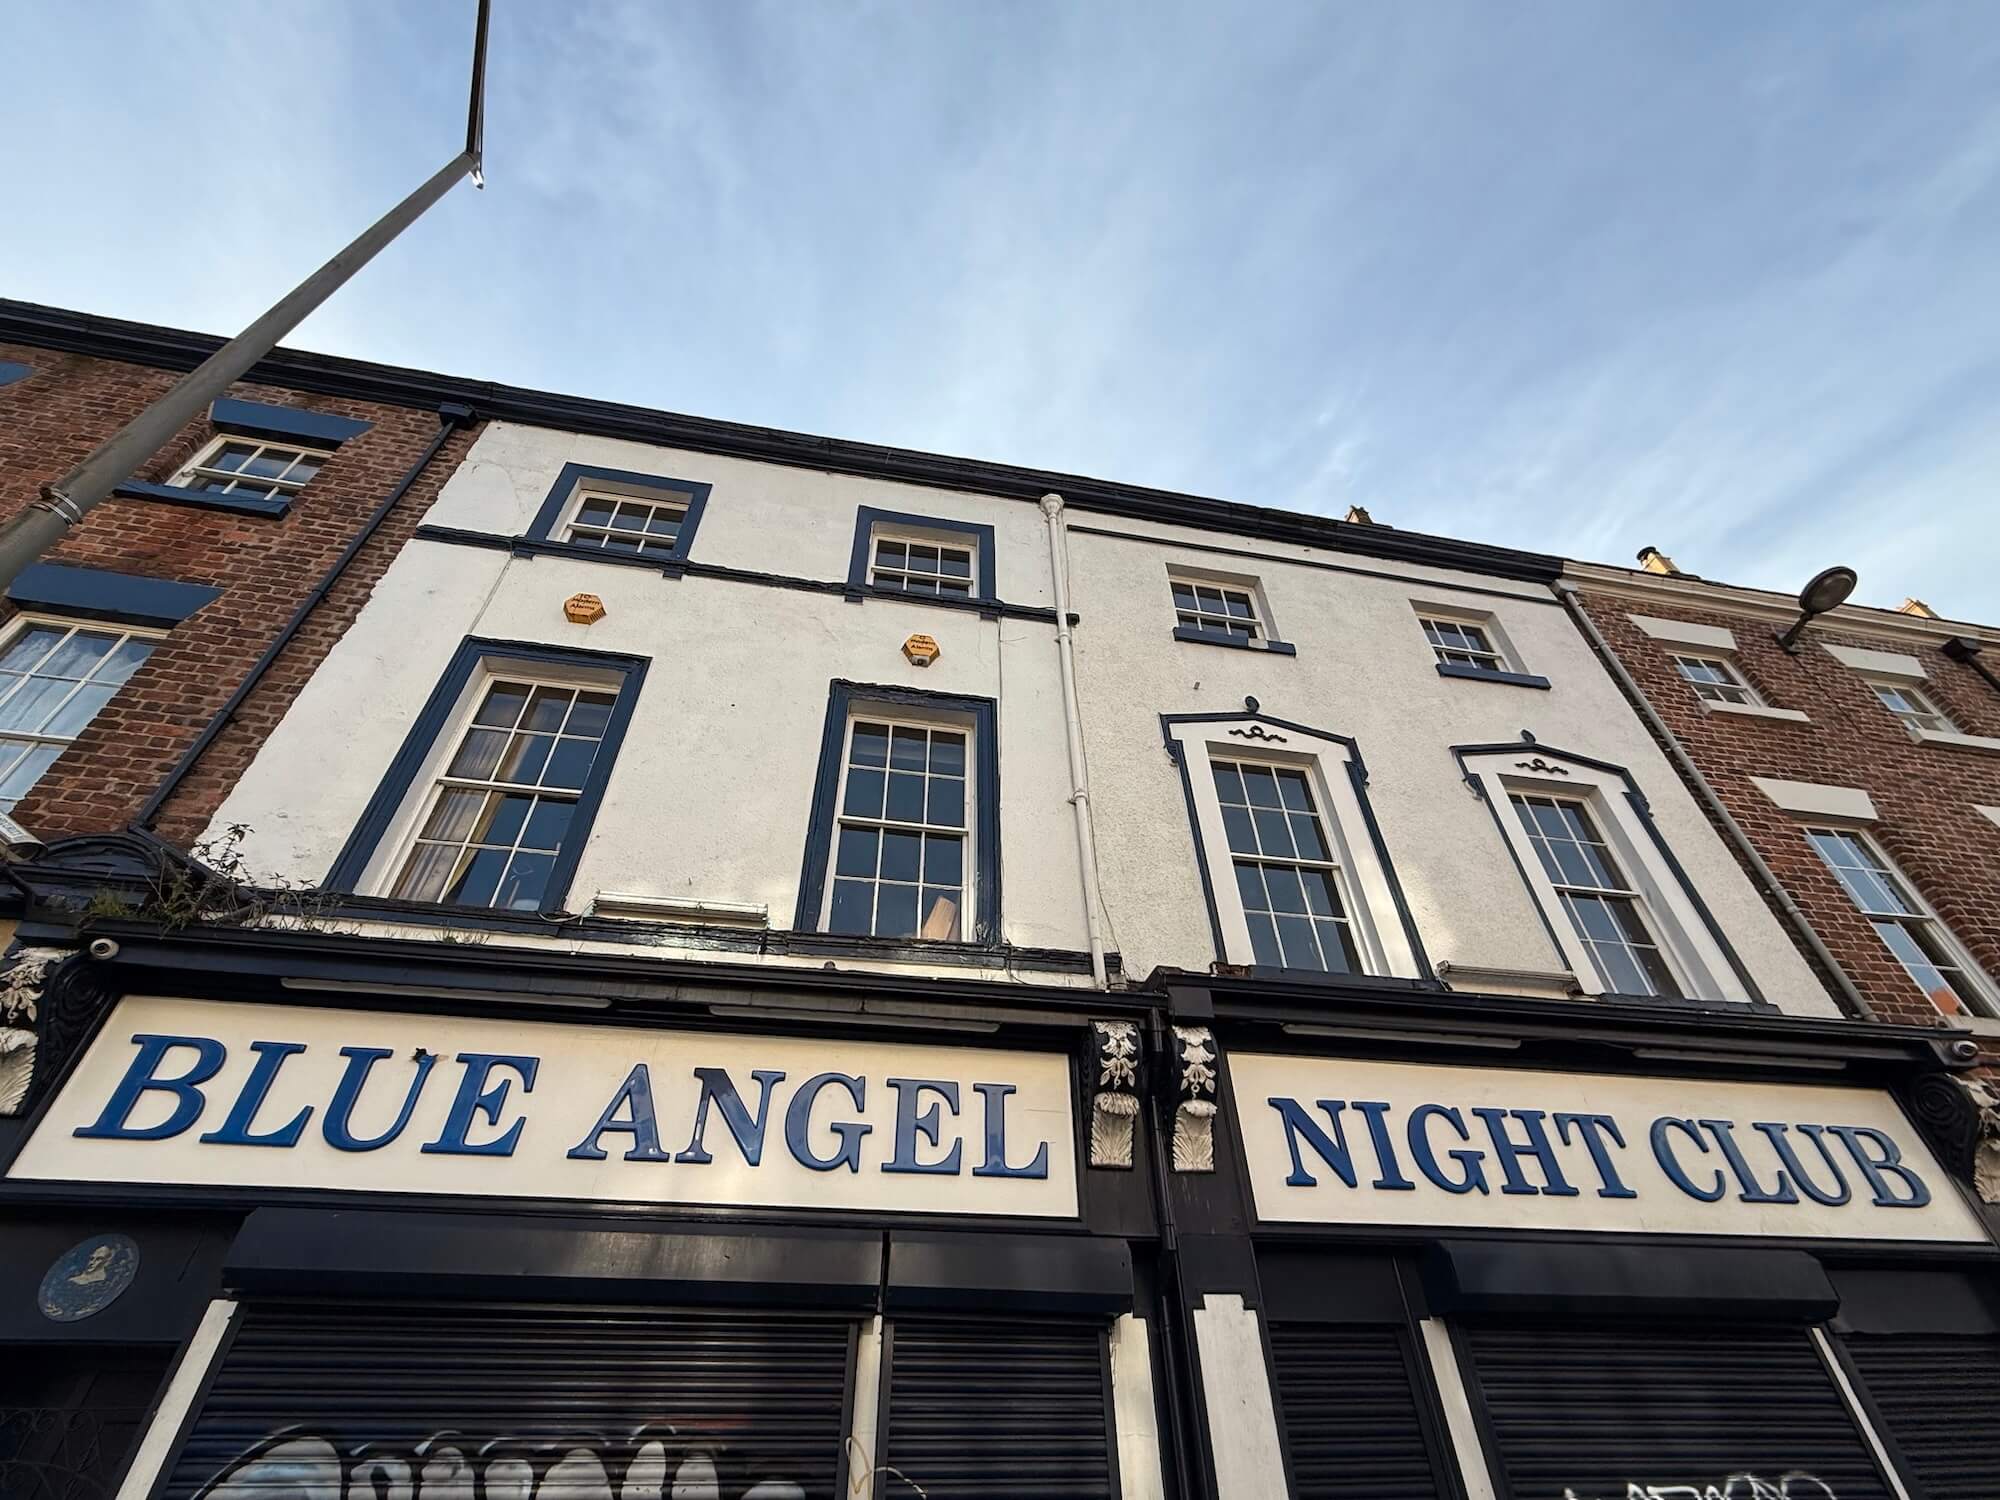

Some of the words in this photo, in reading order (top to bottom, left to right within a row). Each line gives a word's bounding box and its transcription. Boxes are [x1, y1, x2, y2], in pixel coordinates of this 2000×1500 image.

[72, 1034, 540, 1157] BLUE
[566, 1064, 1048, 1180] ANGEL
[1268, 1098, 1637, 1199] NIGHT
[1650, 1117, 1931, 1208] CLUB
